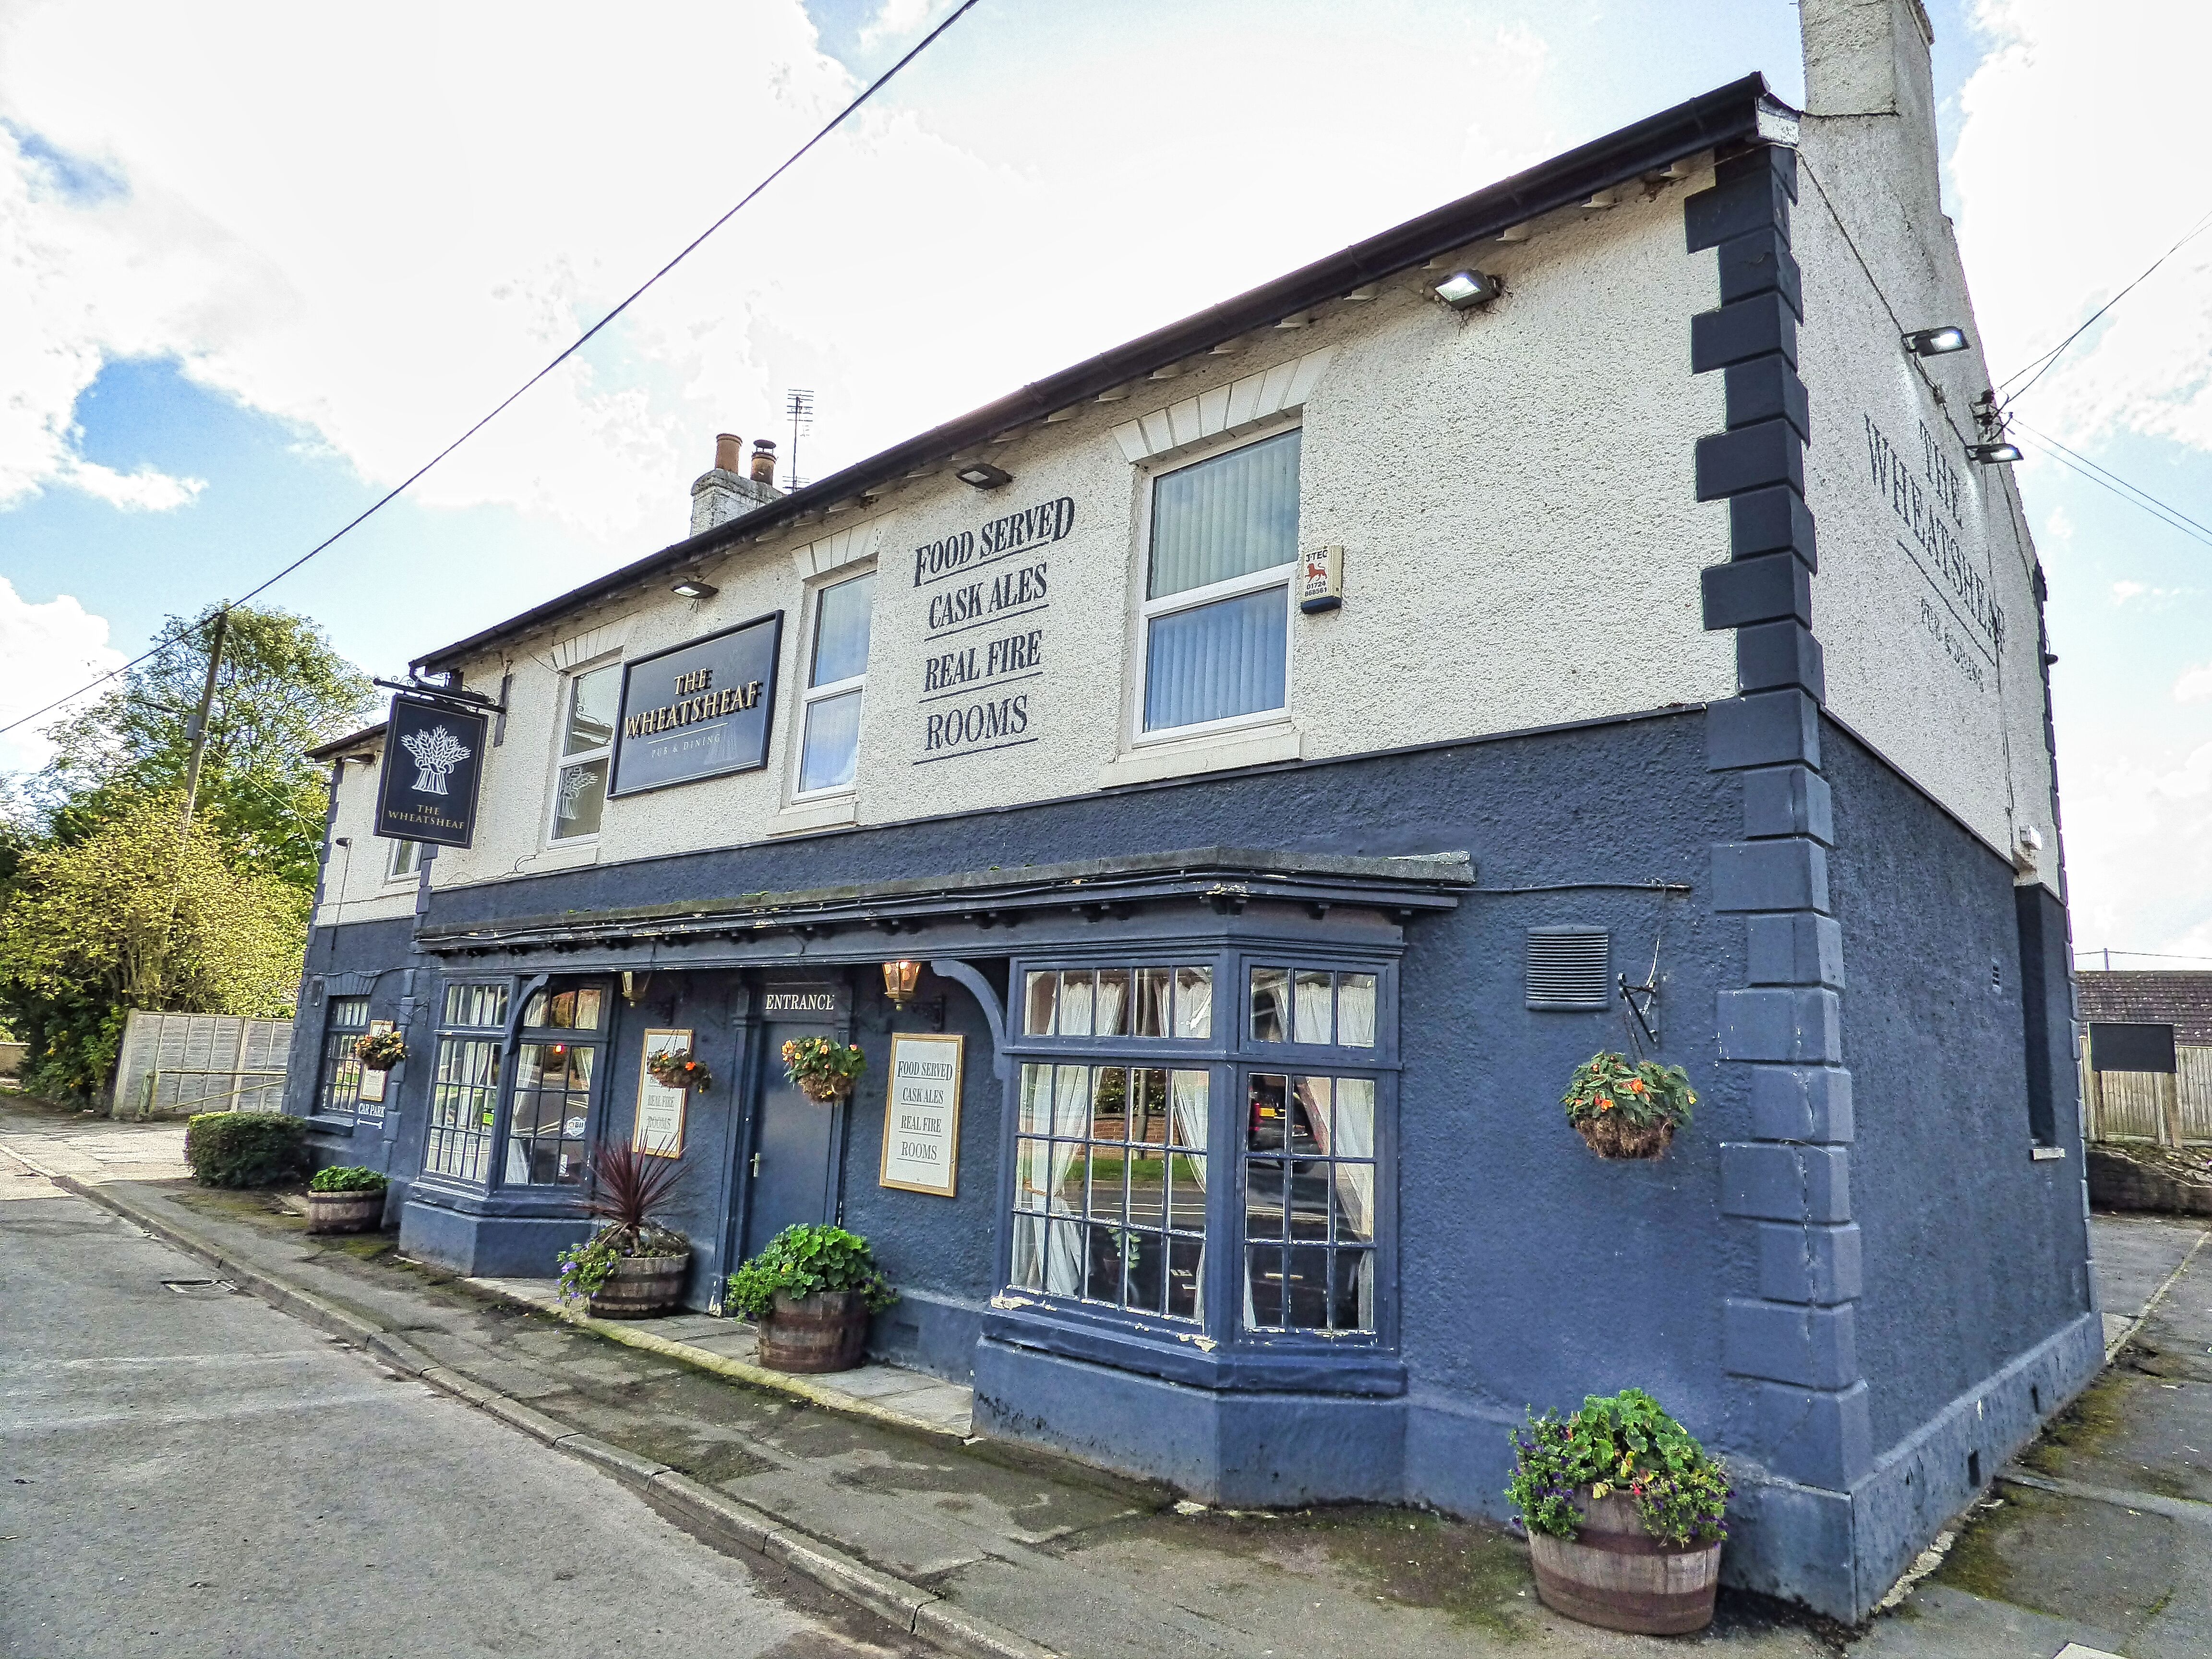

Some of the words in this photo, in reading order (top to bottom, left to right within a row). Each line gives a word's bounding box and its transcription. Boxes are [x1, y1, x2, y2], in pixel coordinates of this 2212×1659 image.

[1919, 418, 1964, 530] THE
[913, 530, 974, 588] FOOD
[979, 496, 1075, 560] SERVED
[1863, 410, 2006, 655] WHEATSHEAF
[928, 582, 984, 630] CASK
[987, 561, 1048, 613] ALES
[923, 647, 981, 693] REAL
[985, 629, 1043, 677] FIRE
[674, 668, 709, 696] THE
[625, 680, 760, 739] WHEATSHEAF
[924, 695, 1028, 751] ROOMS
[651, 746, 668, 758] PUB
[683, 733, 721, 750] DINING
[388, 810, 465, 830] WHEATSHEAF
[416, 804, 440, 816] THE
[765, 994, 834, 1010] ENTRANCE
[897, 1061, 920, 1077] FOOD
[922, 1062, 953, 1081] SERVED
[902, 1087, 922, 1102] CASK
[923, 1089, 944, 1104] ALES
[358, 1103, 369, 1115] CAR
[369, 1104, 386, 1118] PARK
[901, 1115, 921, 1130] REAL
[923, 1117, 942, 1132] FIRE
[901, 1141, 937, 1160] ROOMS
